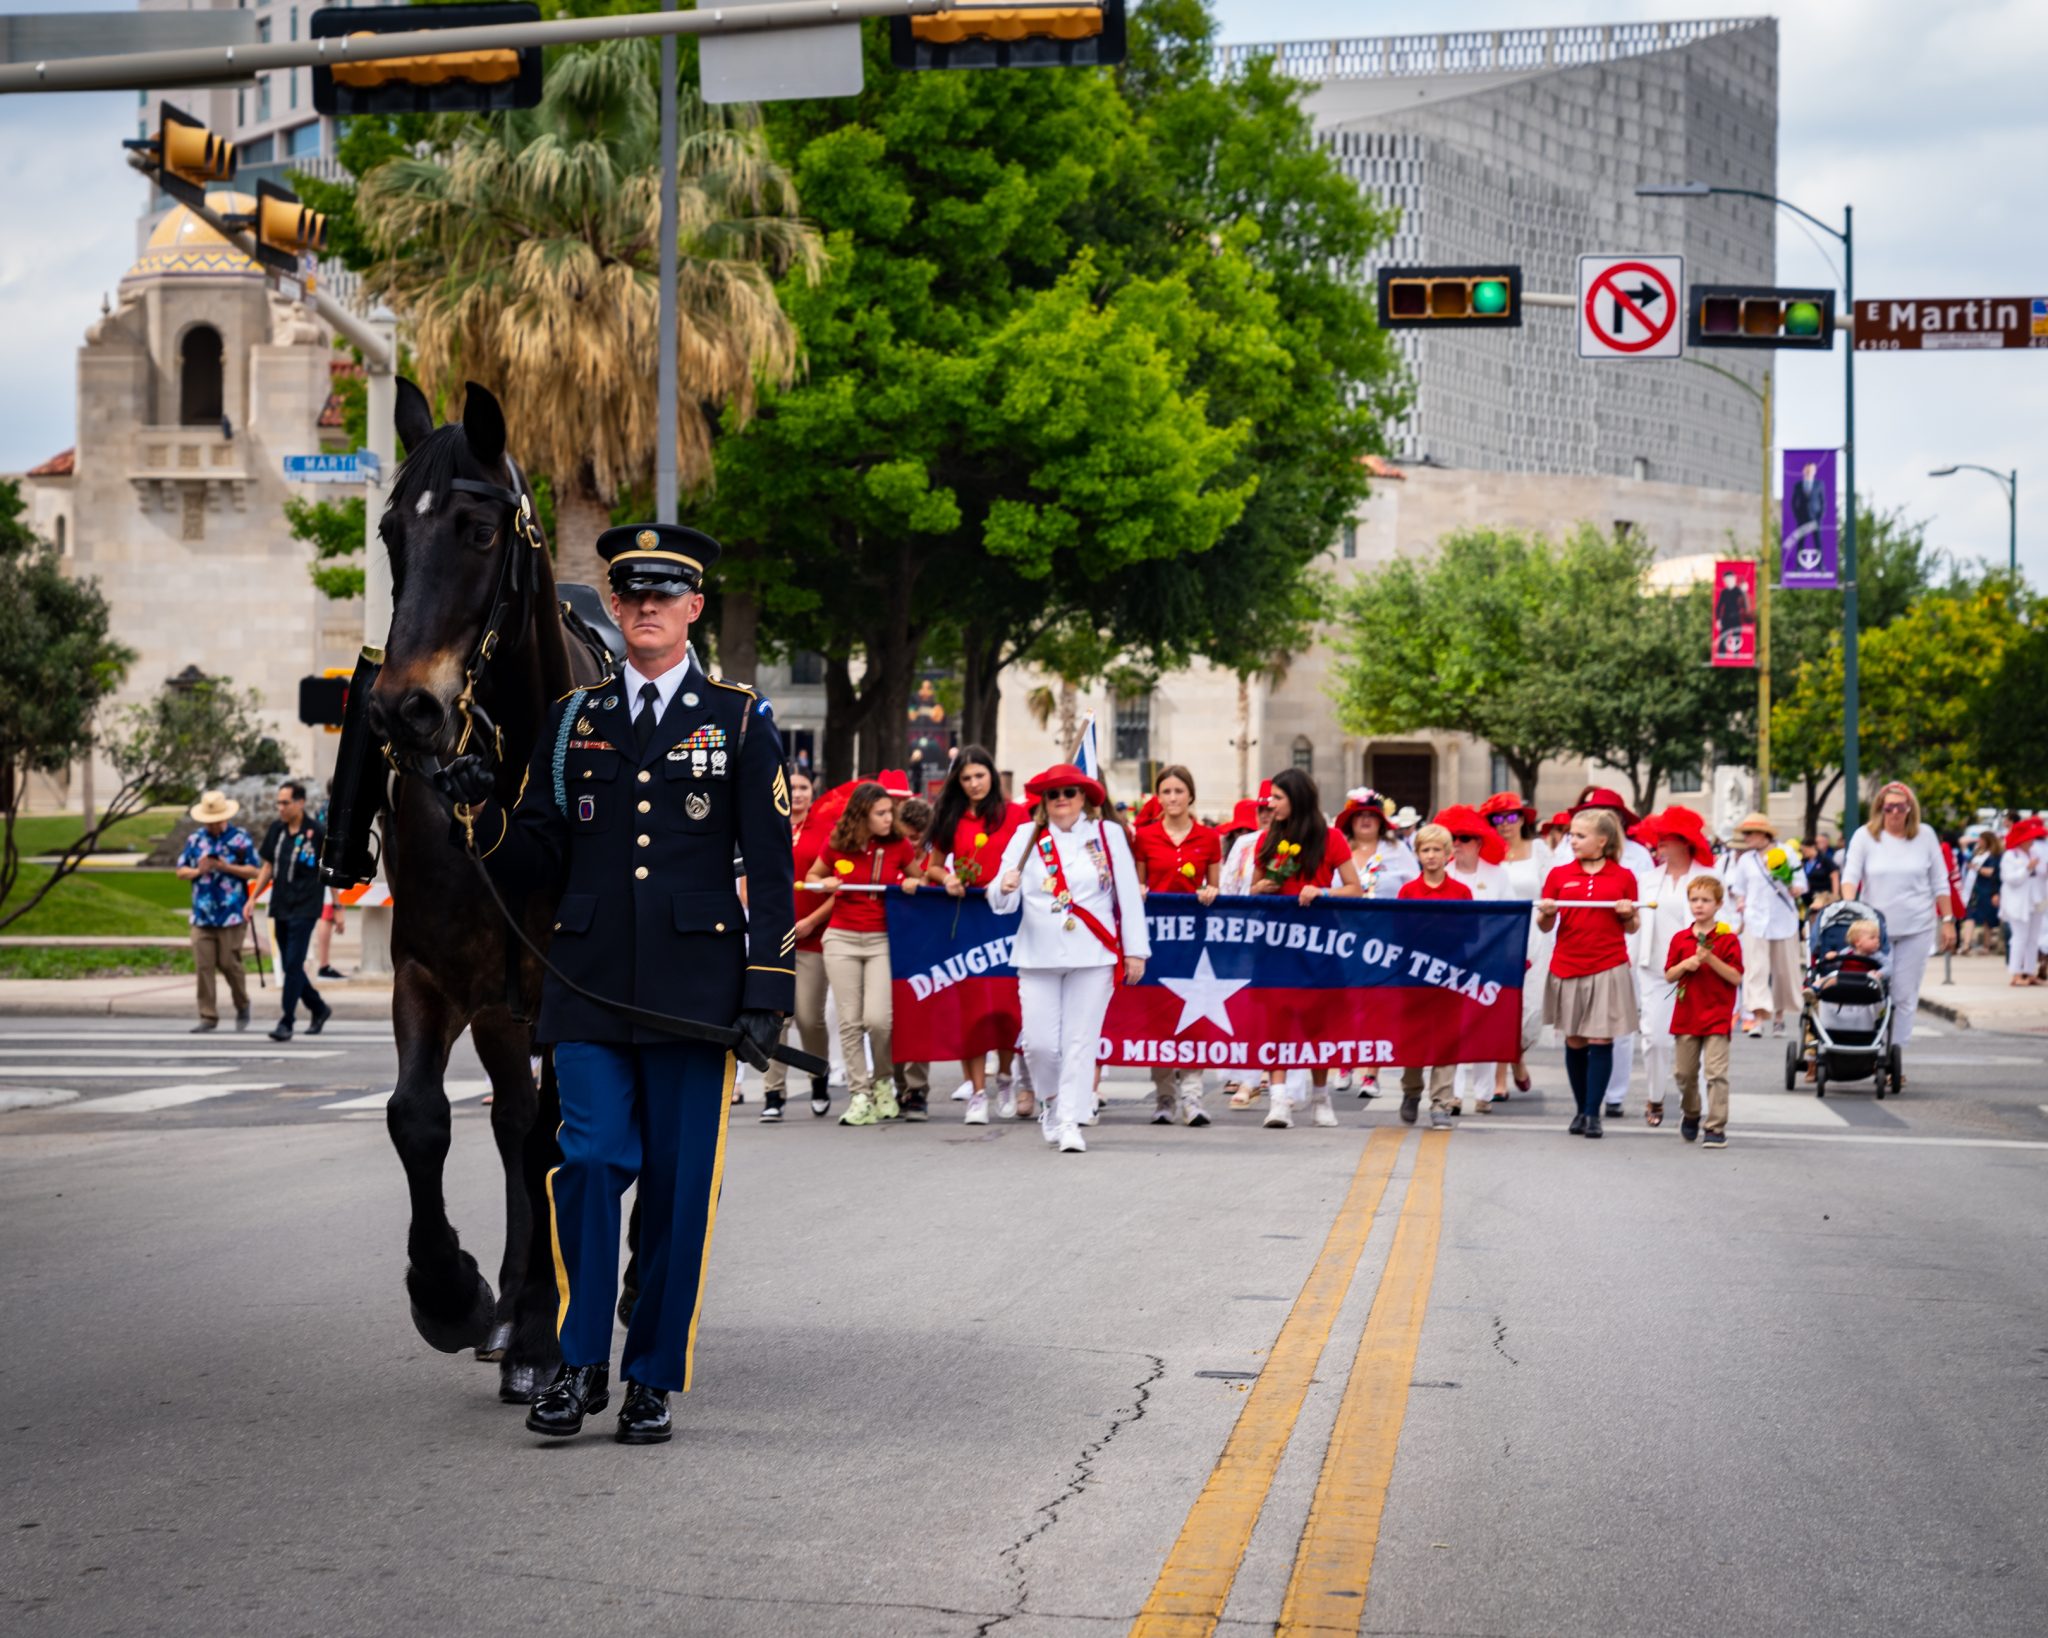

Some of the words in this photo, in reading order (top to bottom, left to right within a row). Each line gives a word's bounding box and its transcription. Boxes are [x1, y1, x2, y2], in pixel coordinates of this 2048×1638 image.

[1867, 303, 1880, 321] E
[1890, 300, 2017, 331] Martin
[1205, 916, 1357, 958] REPUBLIC
[1362, 938, 1403, 968] OF
[1408, 951, 1502, 1006] TEXAS
[1122, 1039, 1249, 1064] MISSION
[1258, 1040, 1394, 1065] CHAPTER
